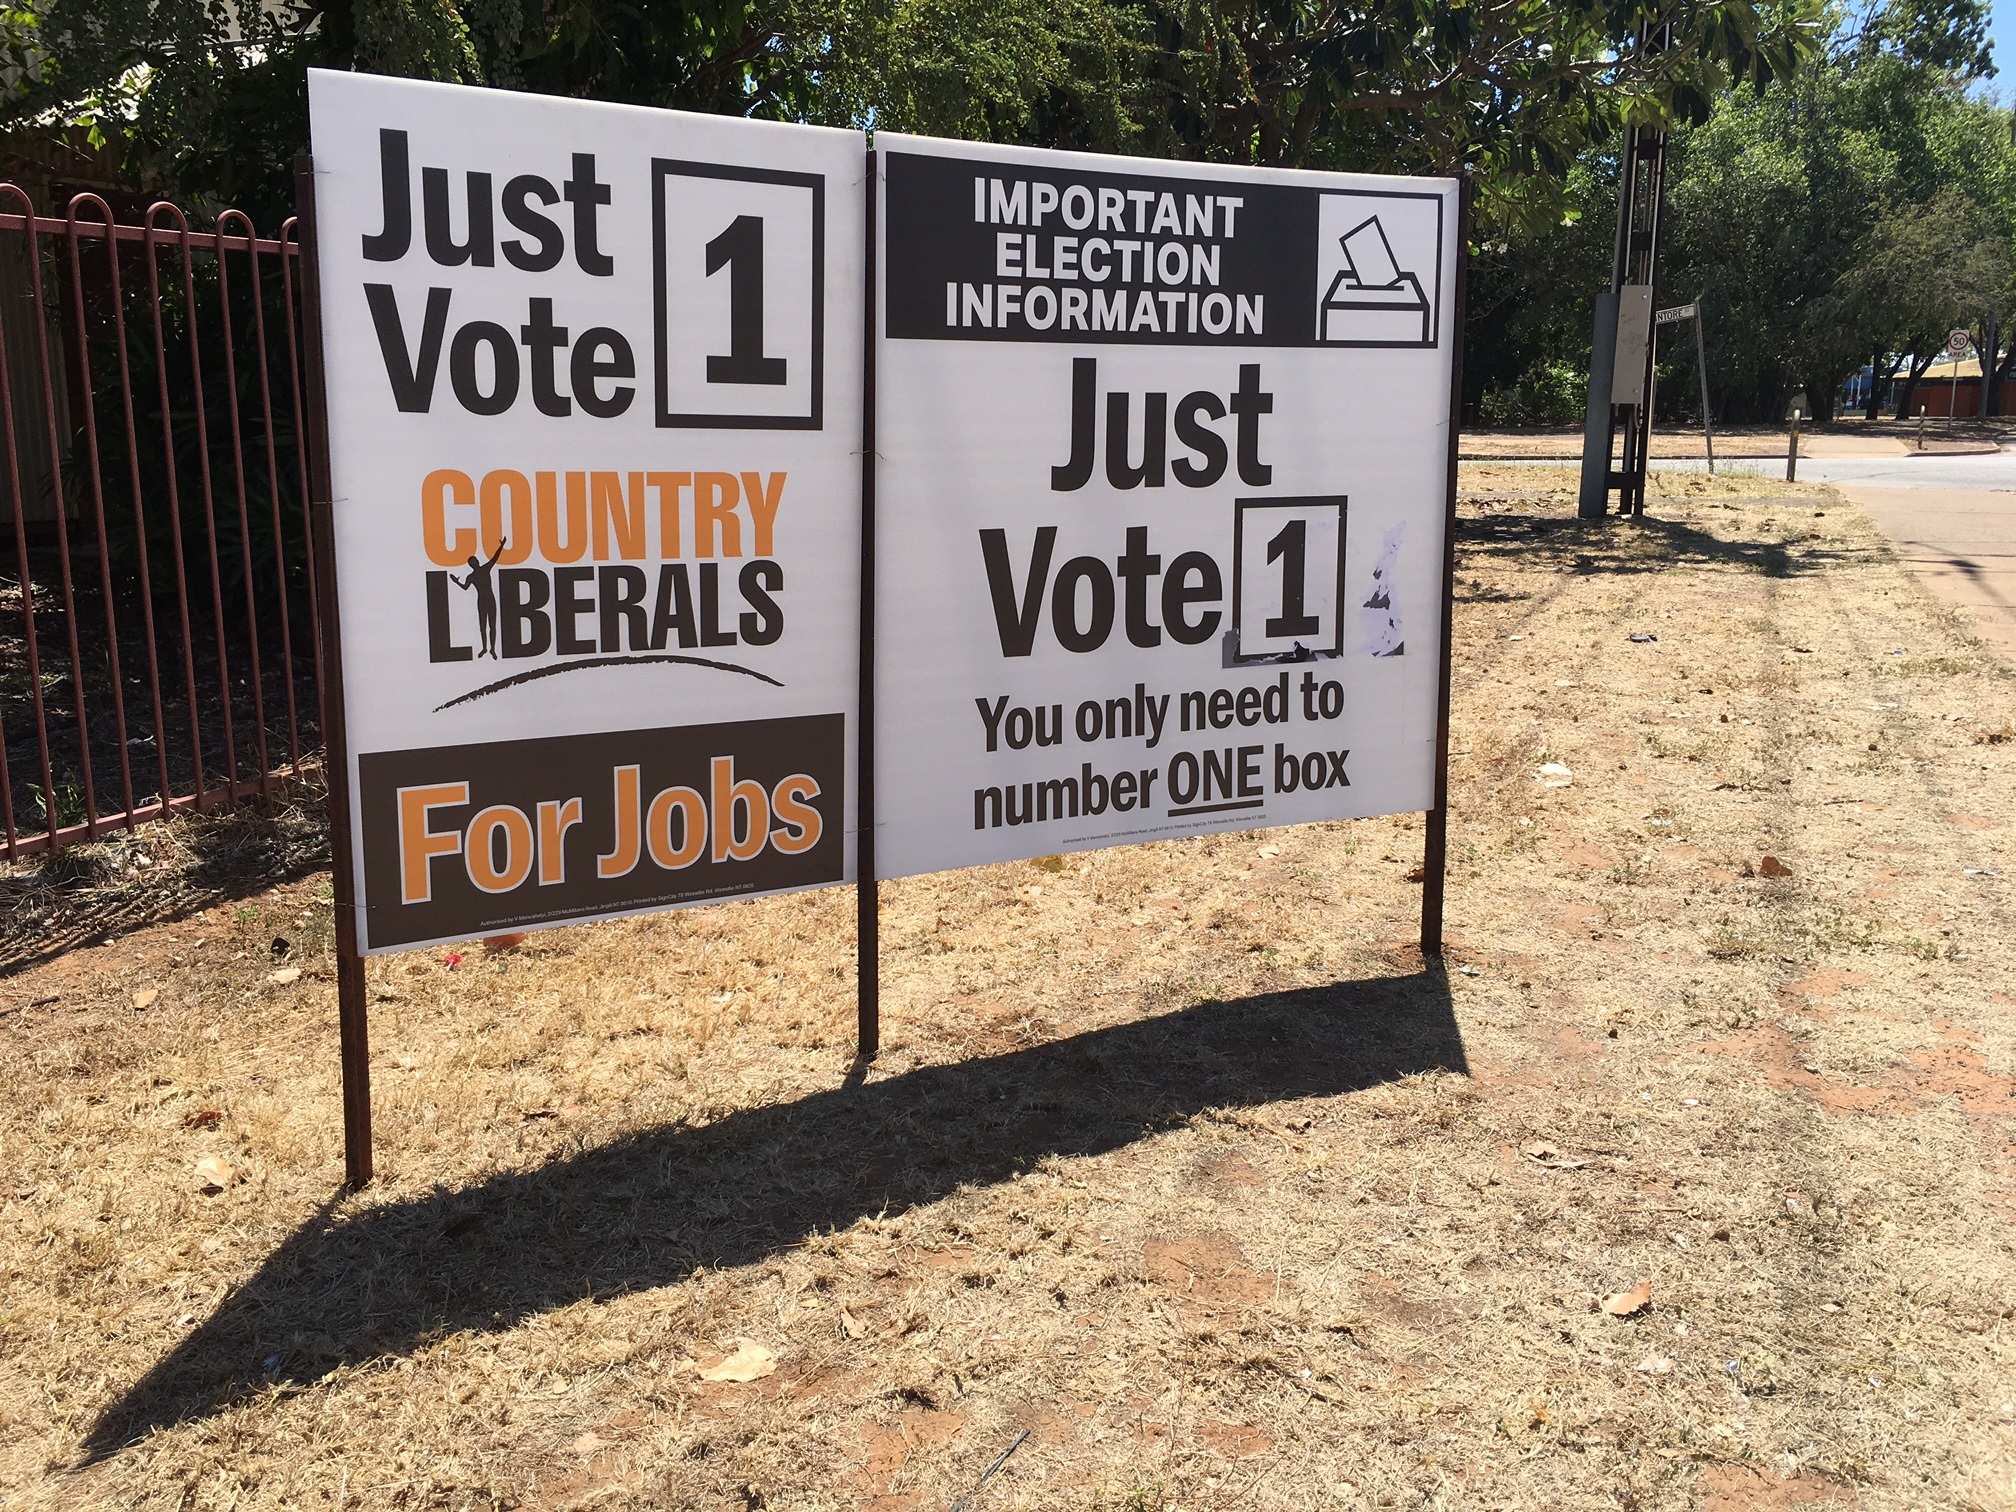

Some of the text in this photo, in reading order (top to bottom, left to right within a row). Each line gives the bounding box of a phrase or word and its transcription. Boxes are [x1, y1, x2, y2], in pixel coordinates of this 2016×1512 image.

[362, 128, 613, 276] Just
[974, 176, 1244, 239] IMPORTANT
[706, 215, 787, 385] 1
[997, 232, 1221, 286] ELECTION
[363, 283, 635, 418] Vote
[946, 282, 1264, 335] INFORMATION
[1657, 309, 1683, 321] NTORE
[1953, 337, 1965, 346] 50
[1051, 358, 1273, 491] Just
[422, 469, 786, 567] COUNTRY
[979, 520, 1319, 657] Vote 1
[975, 672, 1345, 752] You only need to
[398, 755, 823, 904] For Jobs
[974, 763, 1159, 831] number
[1168, 745, 1265, 806] ONE
[1275, 743, 1351, 794] box
